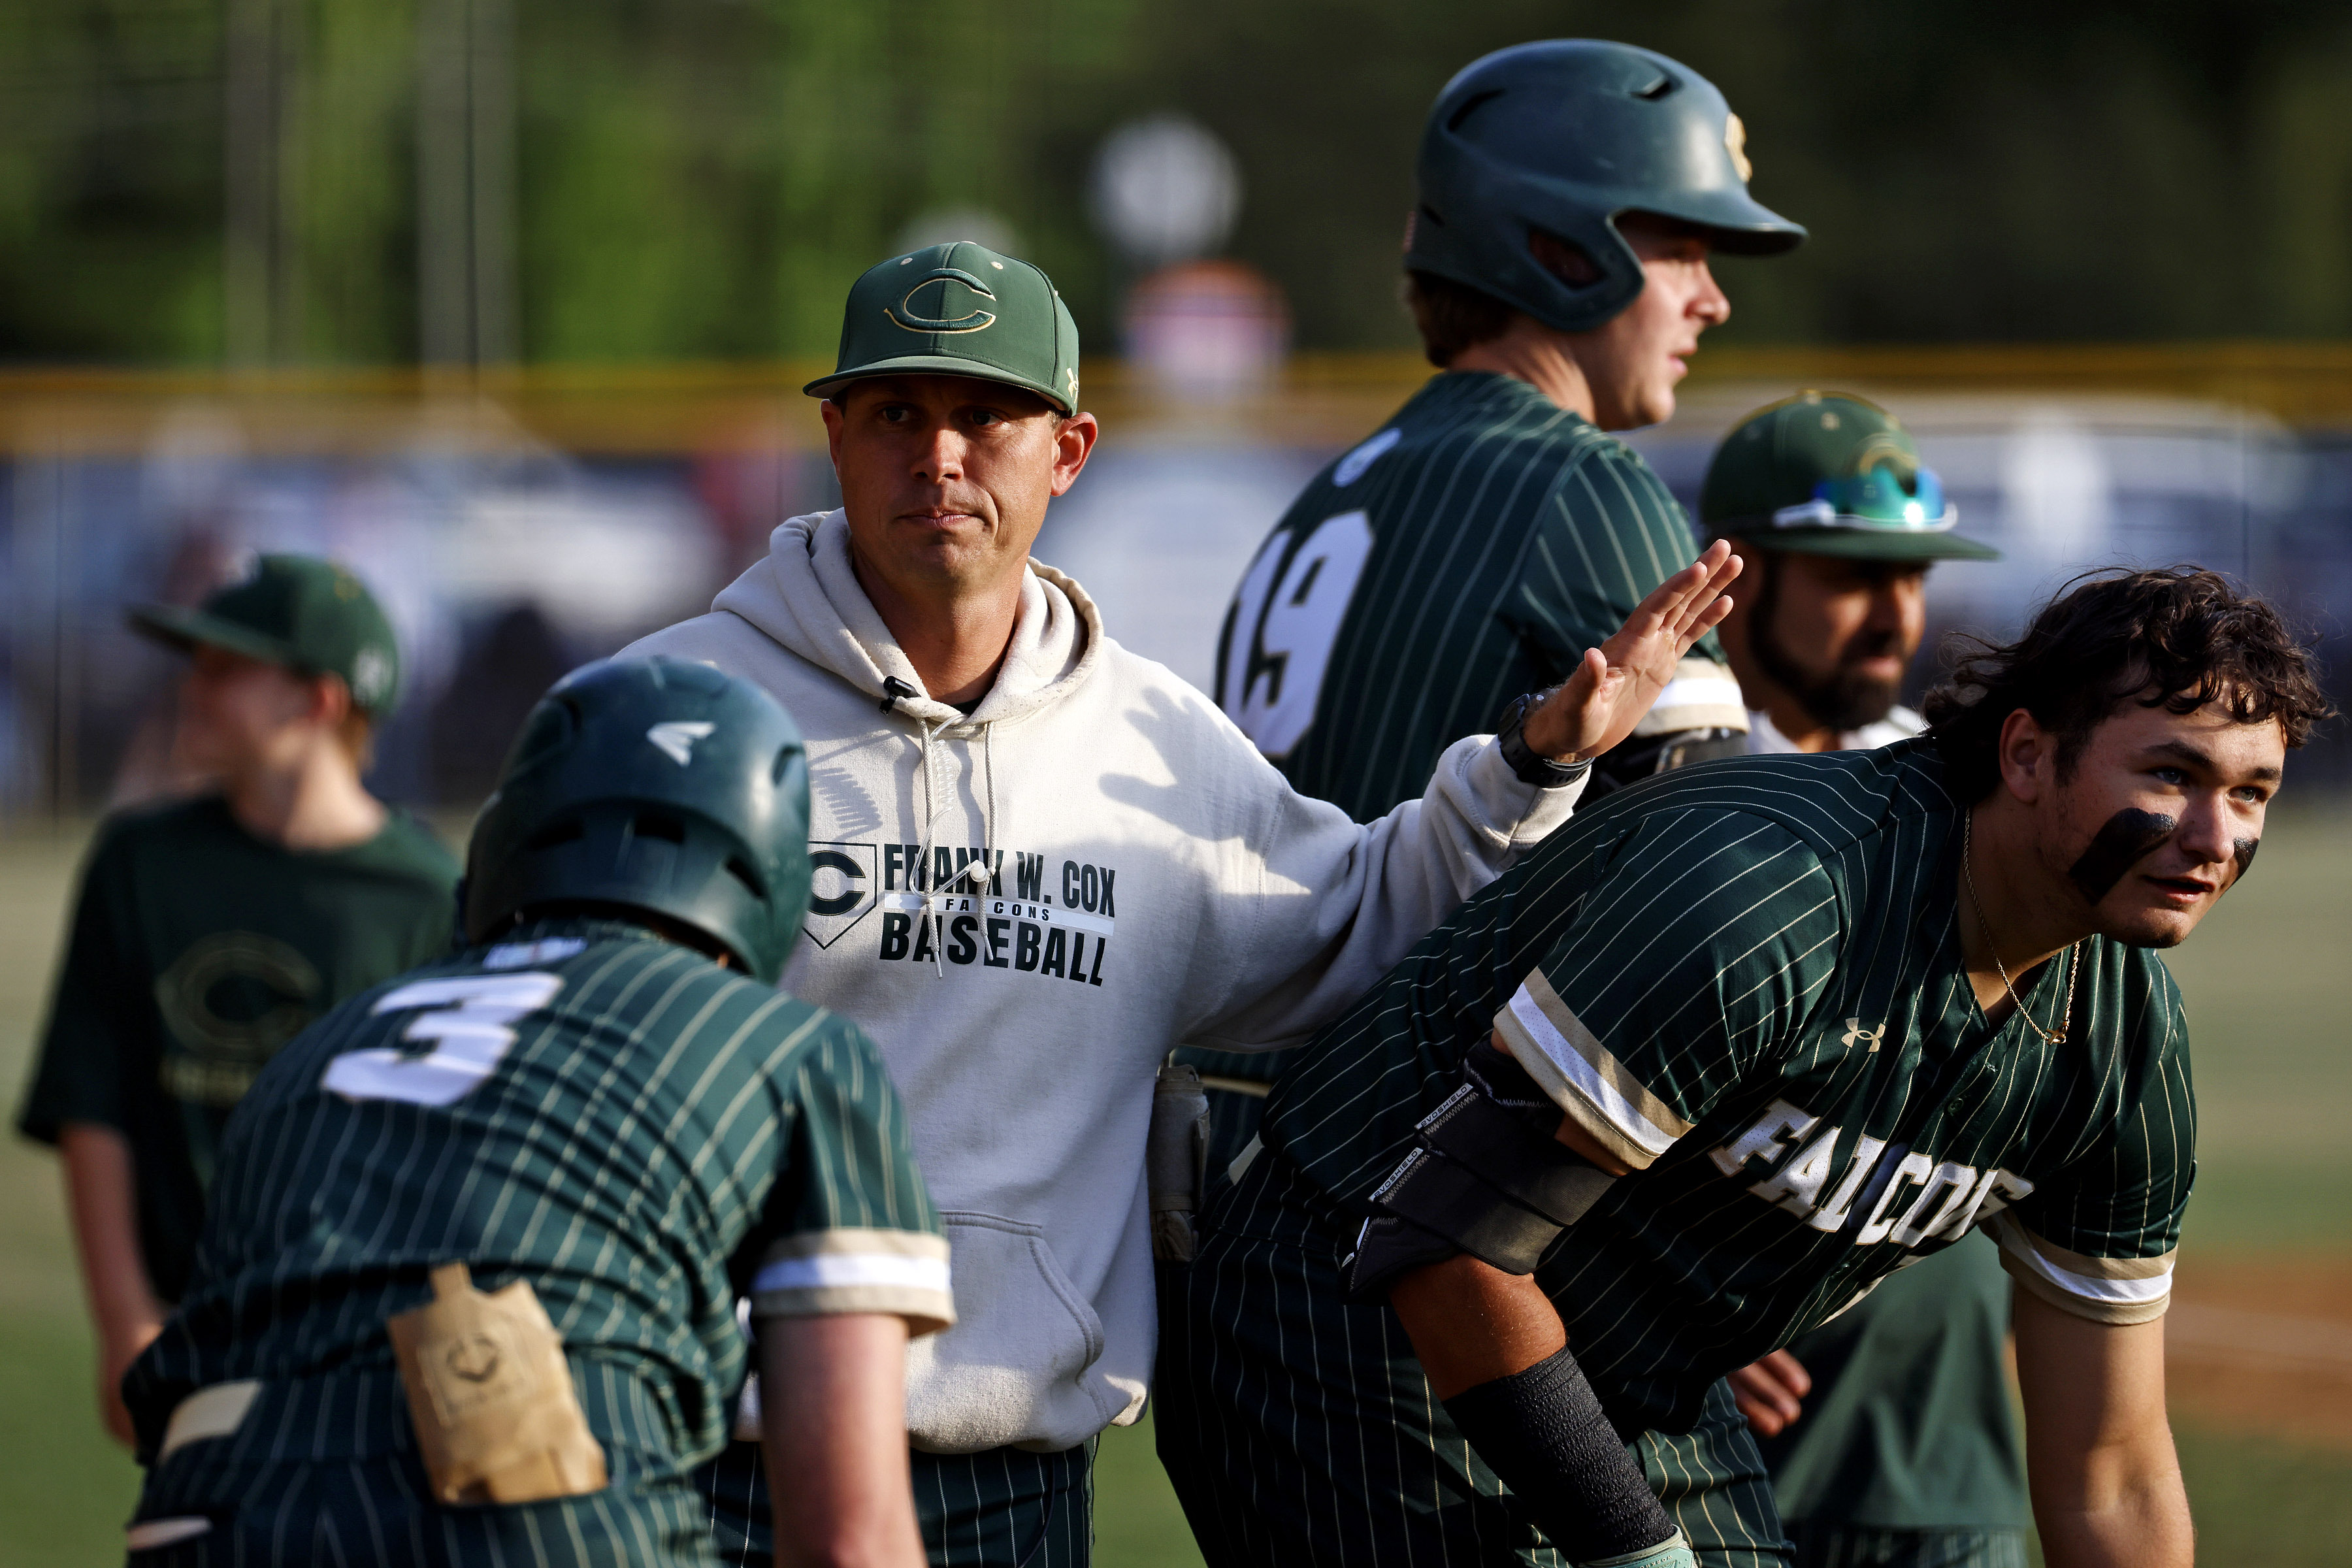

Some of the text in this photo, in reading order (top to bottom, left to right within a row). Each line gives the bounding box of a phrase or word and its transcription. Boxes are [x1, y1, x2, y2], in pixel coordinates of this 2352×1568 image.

[883, 267, 996, 334] C
[1222, 508, 1375, 757] 19
[808, 850, 866, 916] C
[945, 898, 1049, 921] FACONS
[1016, 851, 1052, 905] W.
[1062, 860, 1116, 919] COX
[879, 912, 1106, 987] BASEBALL
[319, 971, 566, 1108] 3
